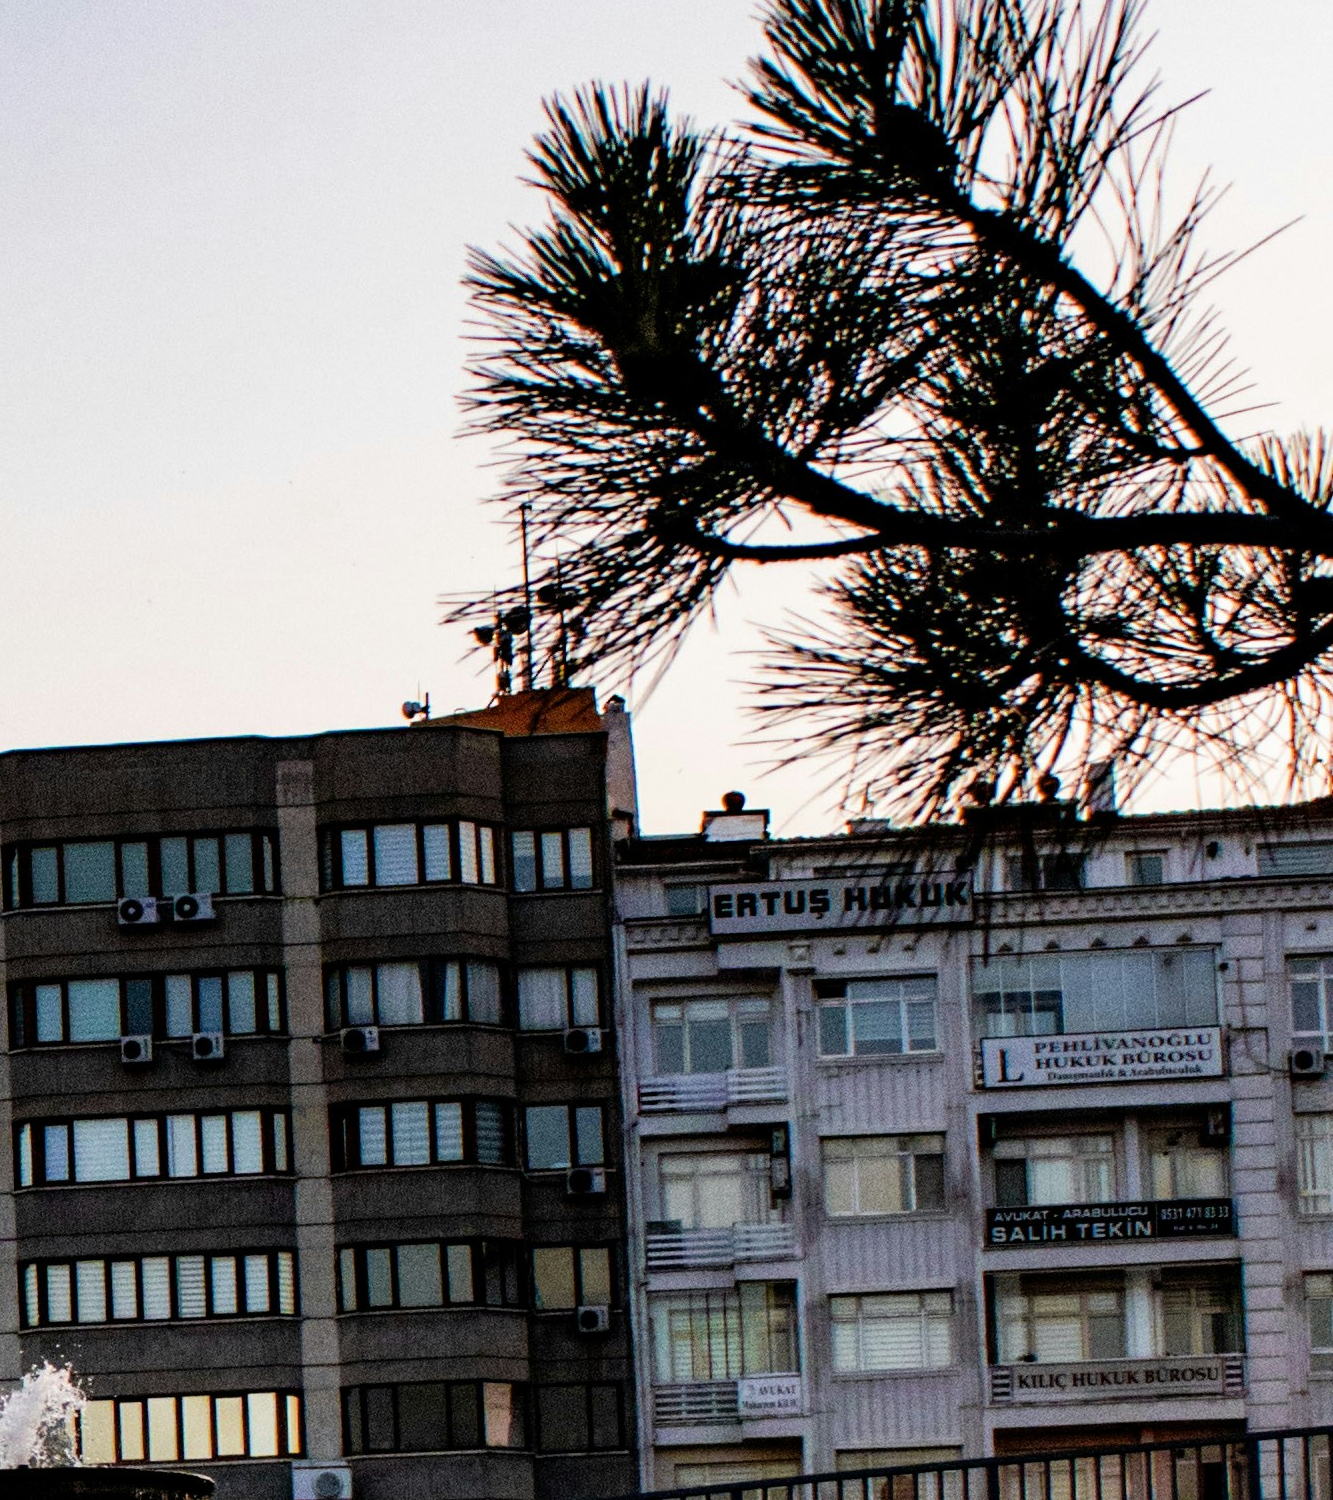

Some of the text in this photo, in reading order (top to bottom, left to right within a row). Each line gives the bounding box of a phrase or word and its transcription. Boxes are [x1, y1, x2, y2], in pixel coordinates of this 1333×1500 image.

[713, 881, 969, 920] ERTUŞ HUKUK
[1034, 1031, 1213, 1054] PEHLİVANOĞLU
[1035, 1048, 1213, 1070] HUKUK BÜROSU
[994, 1210, 1050, 1222] AVUKAT
[1062, 1206, 1149, 1220] ARABULUCU
[991, 1218, 1153, 1243] SALİH TEKİN
[1018, 1366, 1220, 1390] KILIÇ HUKUK BÜROSU
